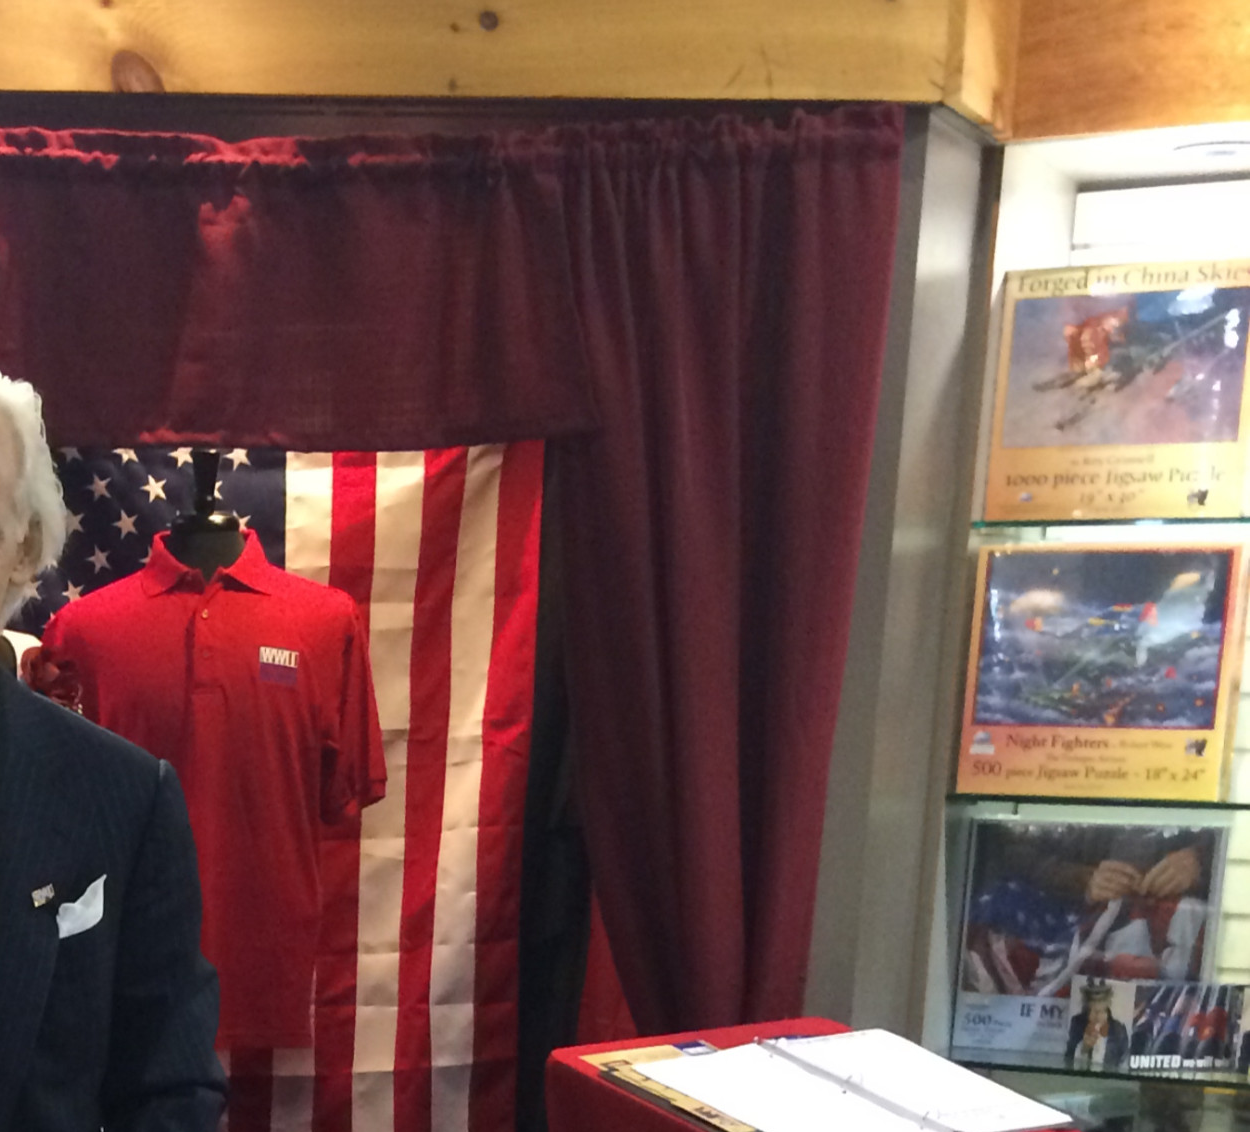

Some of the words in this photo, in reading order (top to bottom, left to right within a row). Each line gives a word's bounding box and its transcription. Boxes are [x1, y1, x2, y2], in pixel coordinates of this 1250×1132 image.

[1018, 271, 1088, 295] Forged
[1124, 268, 1189, 286] China
[1053, 471, 1100, 488] piece
[1105, 468, 1164, 485] Jigsaw
[1006, 735, 1046, 749] Night
[1051, 736, 1109, 750] Fighters
[972, 763, 1001, 776] 500
[1036, 765, 1079, 780] Jigsaw
[1084, 767, 1128, 778] Puzzle
[1020, 1003, 1034, 1017] IF
[1040, 1003, 1065, 1018] MY
[964, 1012, 991, 1026] 500
[1130, 1055, 1181, 1068] UNITED
